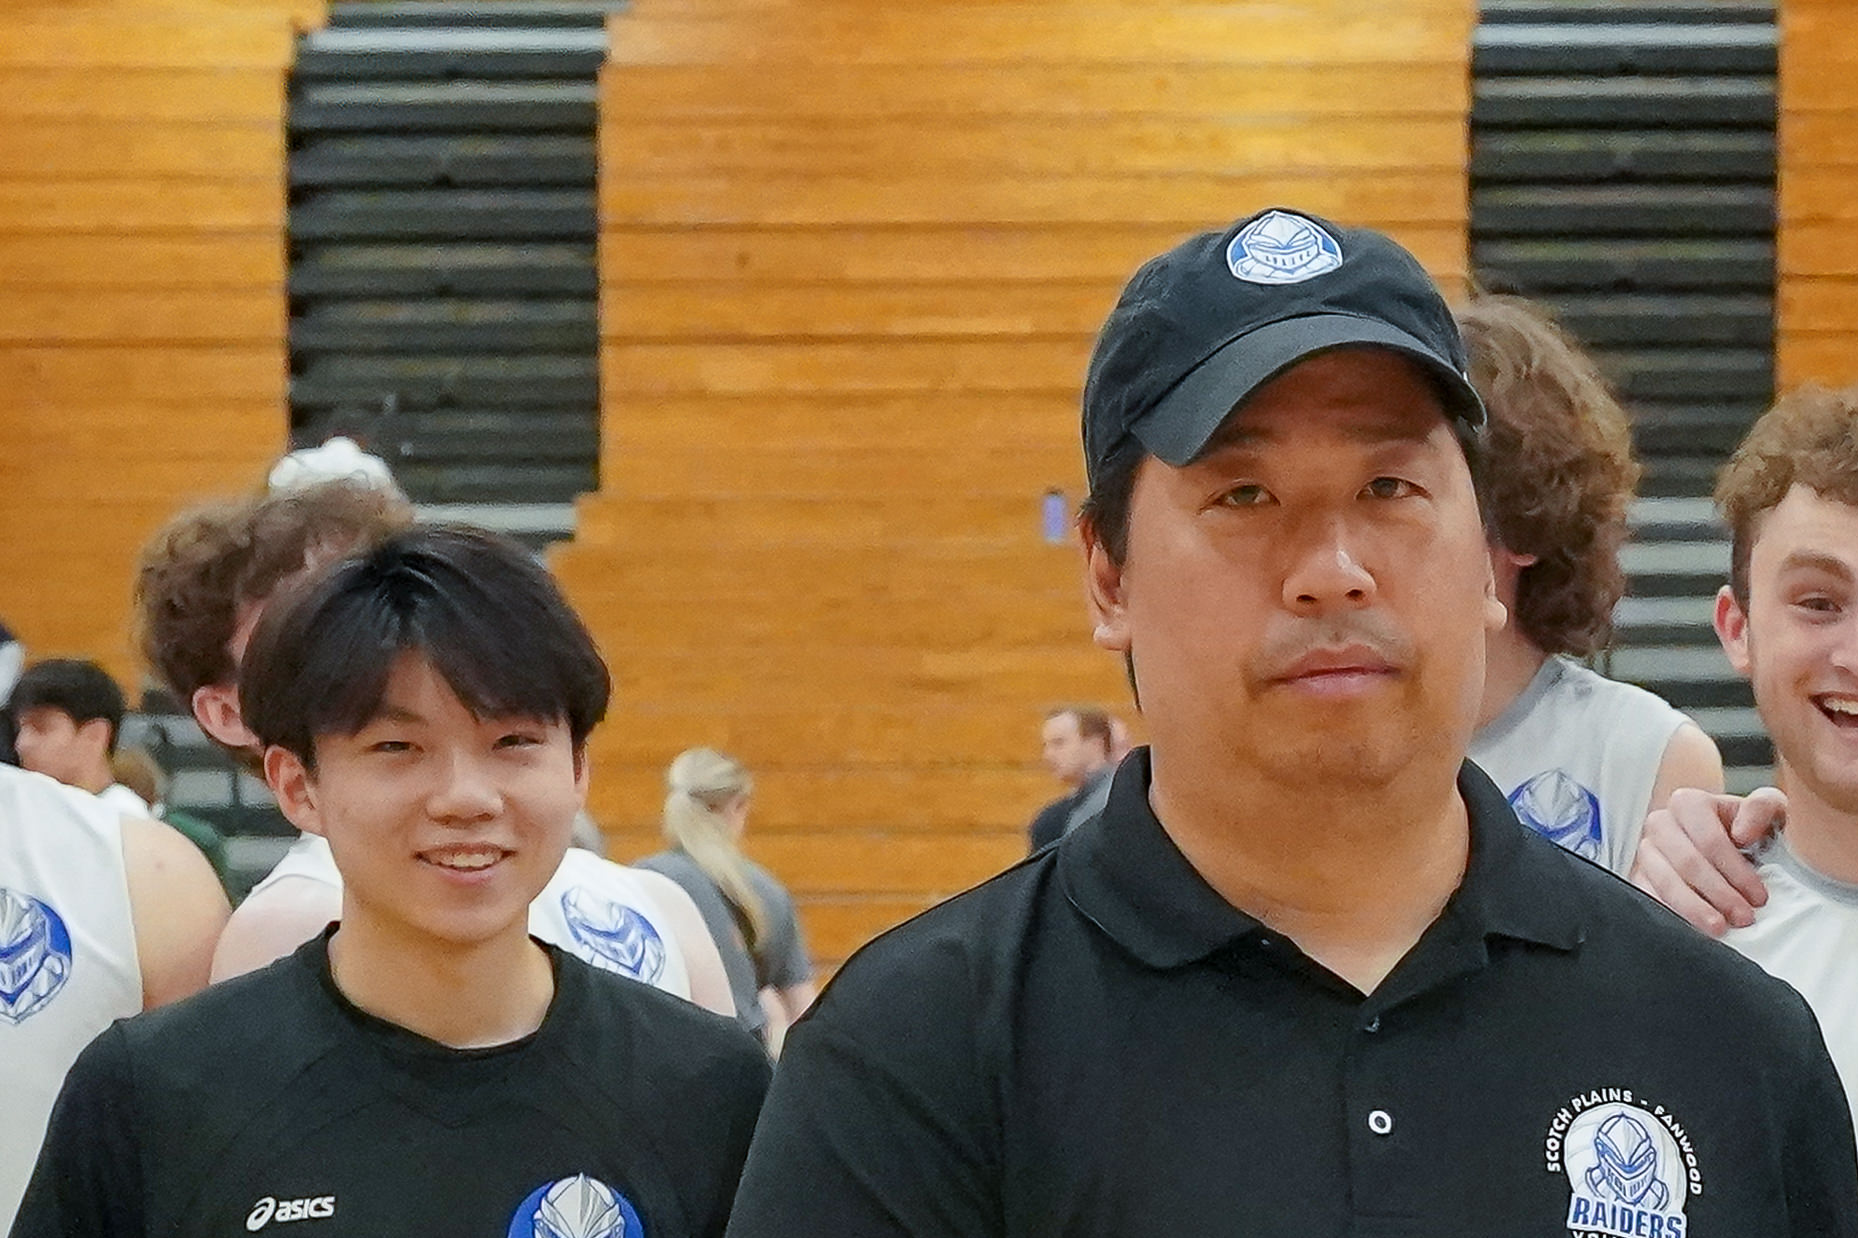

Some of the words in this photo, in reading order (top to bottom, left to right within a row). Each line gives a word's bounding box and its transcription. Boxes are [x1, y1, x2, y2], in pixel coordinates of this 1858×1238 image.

[1545, 1108, 1573, 1172] SCOTCH
[1571, 1088, 1633, 1112] PLAINS
[1654, 1105, 1702, 1195] FANWOOD
